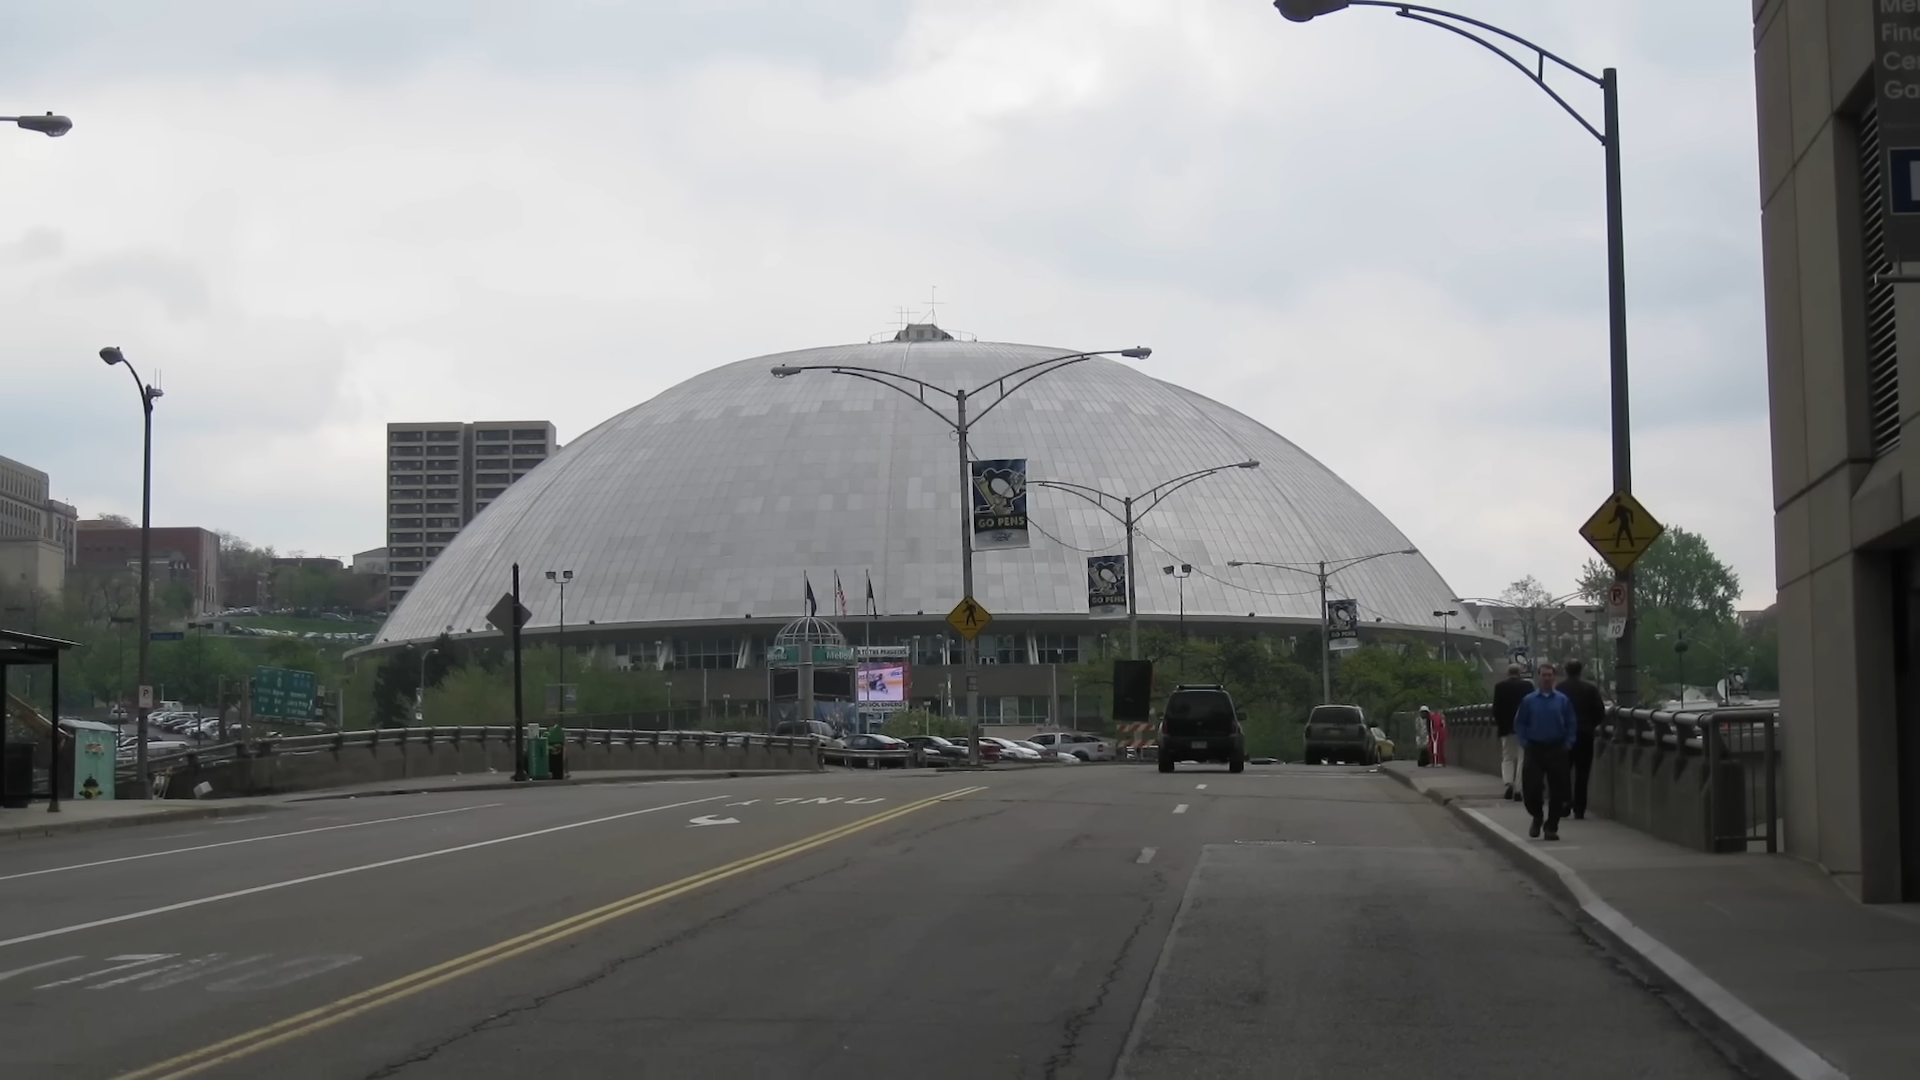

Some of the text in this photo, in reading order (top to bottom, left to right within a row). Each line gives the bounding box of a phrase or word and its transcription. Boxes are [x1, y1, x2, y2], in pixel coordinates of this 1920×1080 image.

[1884, 80, 1920, 99] Ga
[978, 516, 1025, 528] GO PENS
[1612, 624, 1621, 634] 10
